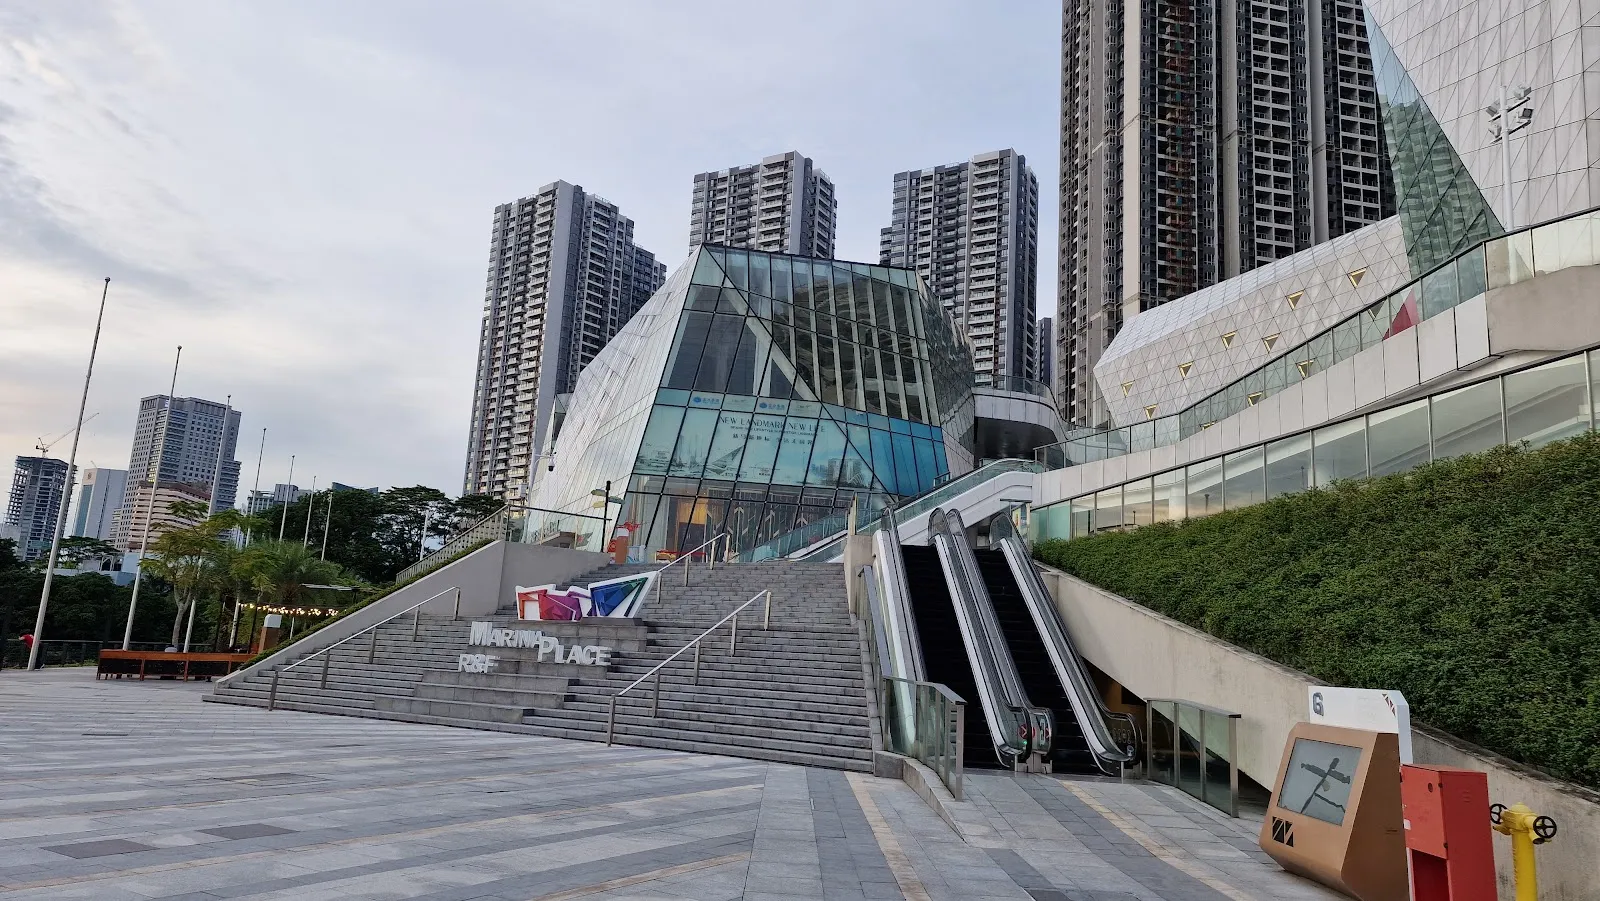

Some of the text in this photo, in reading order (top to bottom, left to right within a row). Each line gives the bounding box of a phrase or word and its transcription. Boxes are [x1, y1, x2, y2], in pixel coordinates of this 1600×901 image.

[788, 422, 806, 430] NEW
[469, 621, 611, 666] MARINA PLACE
[458, 653, 498, 674] R&F
[1312, 692, 1324, 716] 6
